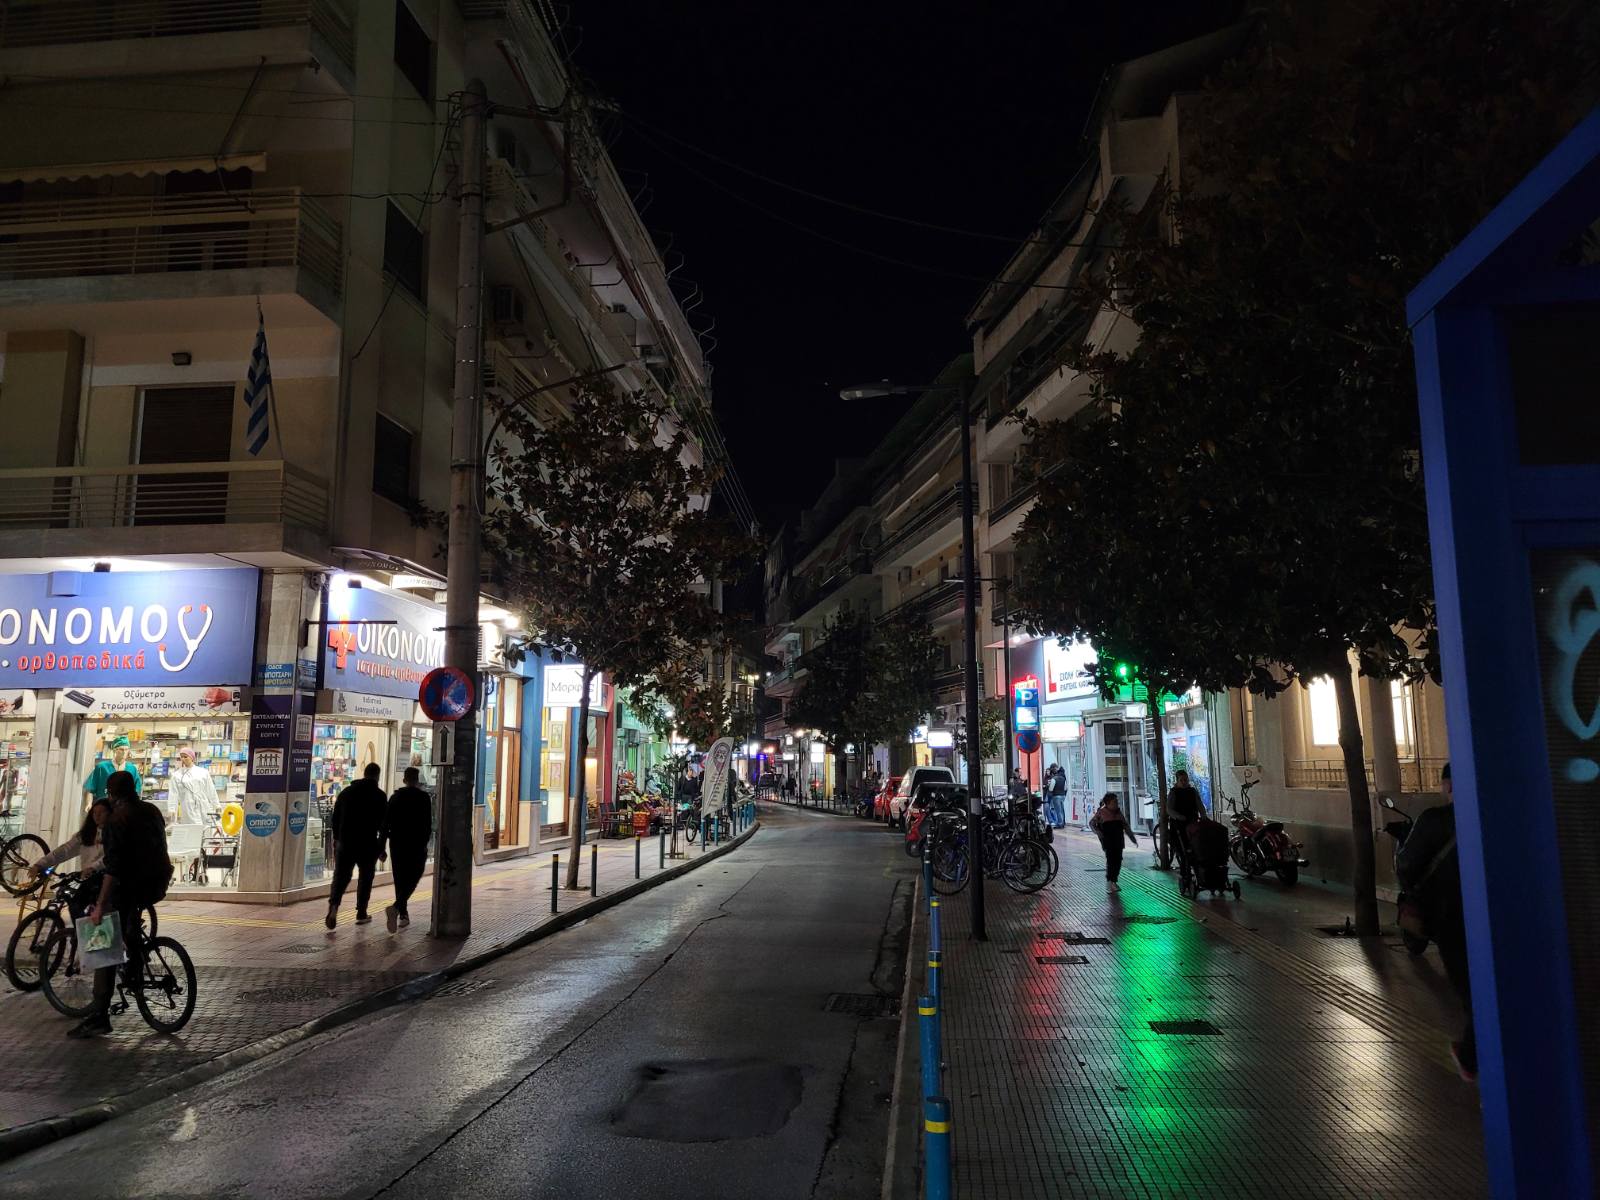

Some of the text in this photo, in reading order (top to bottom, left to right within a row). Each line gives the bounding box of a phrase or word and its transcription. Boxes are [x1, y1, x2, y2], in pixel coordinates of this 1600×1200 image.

[17, 649, 145, 674] ορθοπεδικά
[124, 689, 165, 700] Οξύμετρα
[1021, 690, 1033, 706] P
[101, 701, 196, 712] Στρώματα Κατάκλισης
